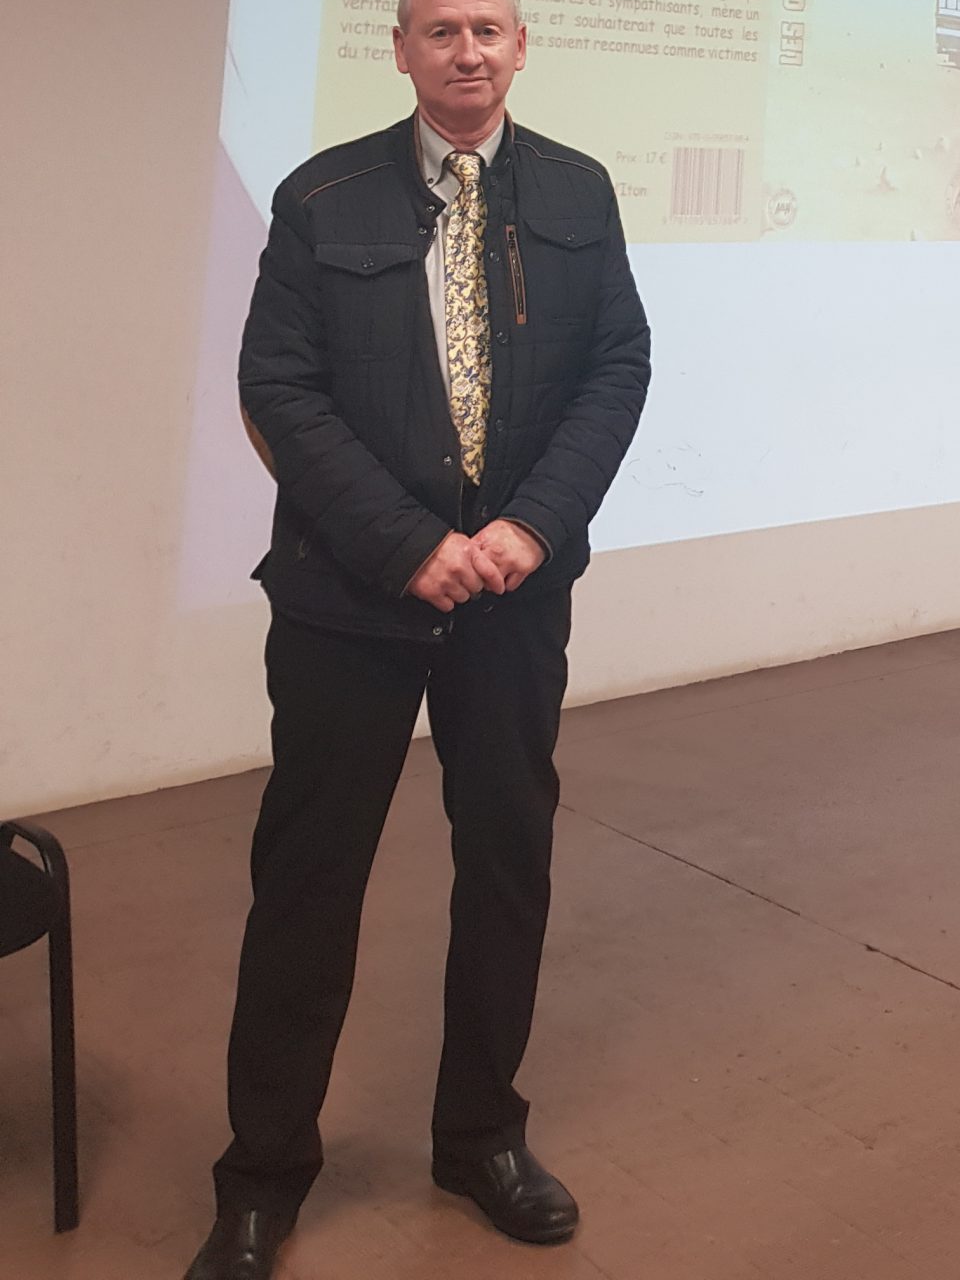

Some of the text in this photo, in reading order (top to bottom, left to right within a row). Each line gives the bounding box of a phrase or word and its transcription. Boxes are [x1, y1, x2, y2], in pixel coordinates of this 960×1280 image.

[710, 2, 742, 19] mène
[745, 9, 759, 20] un
[548, 12, 565, 25] et
[573, 12, 655, 32] souhaiterait
[663, 23, 686, 38] que
[693, 24, 734, 40] toutes
[741, 25, 758, 42] les
[337, 40, 358, 59] du
[546, 35, 591, 50] soient
[592, 39, 659, 55] reconnues
[662, 44, 705, 58] comme
[706, 47, 758, 62] victimes
[779, 21, 804, 67] LES
